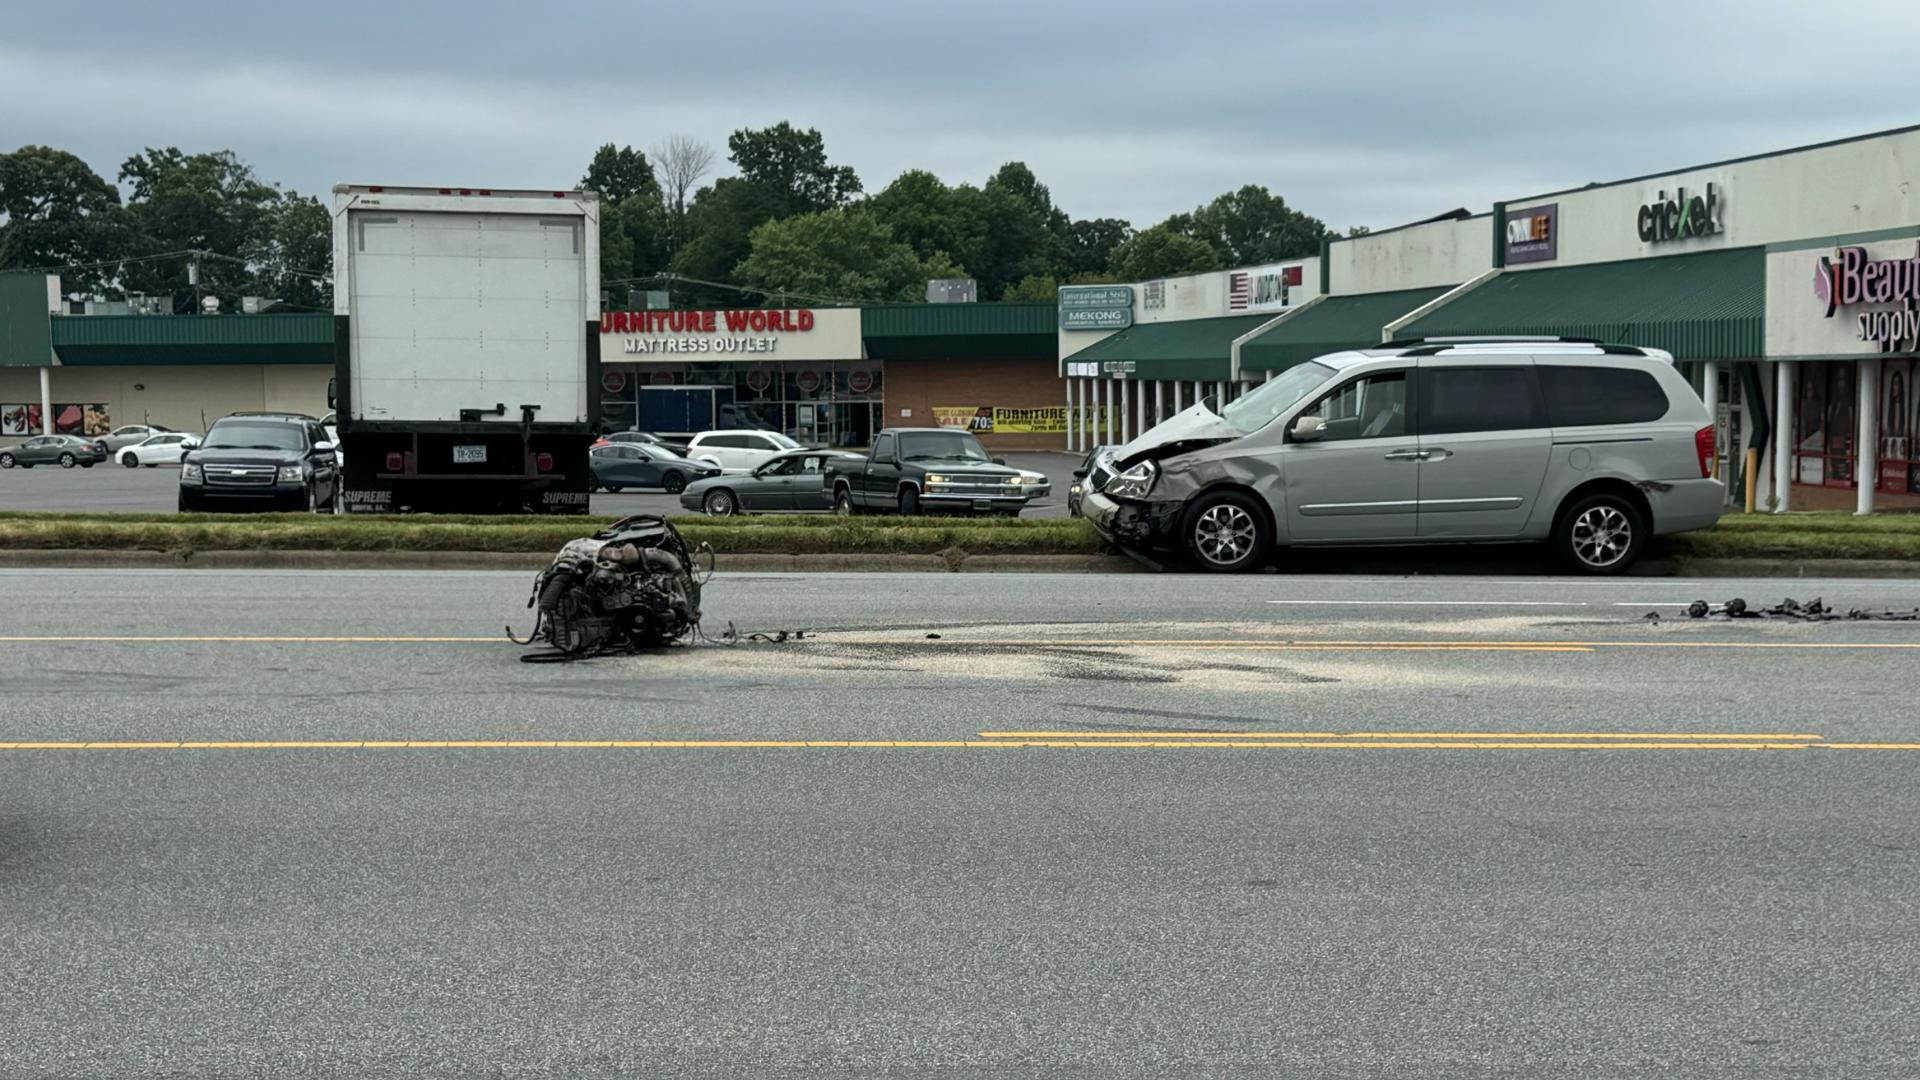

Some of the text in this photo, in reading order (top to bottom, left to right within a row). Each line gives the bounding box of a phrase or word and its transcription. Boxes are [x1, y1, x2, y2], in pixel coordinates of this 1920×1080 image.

[1638, 182, 1722, 244] cricket
[1832, 244, 1920, 304] iBeaut
[600, 309, 814, 333] URNITURE WORLD
[1069, 311, 1121, 320] MEKONG
[1857, 297, 1920, 352] supply
[624, 337, 777, 353] MATTRESS OUTLET
[996, 408, 1066, 419] FURNITURE
[345, 490, 392, 503] SUPREME
[543, 491, 588, 504] SUPREME
